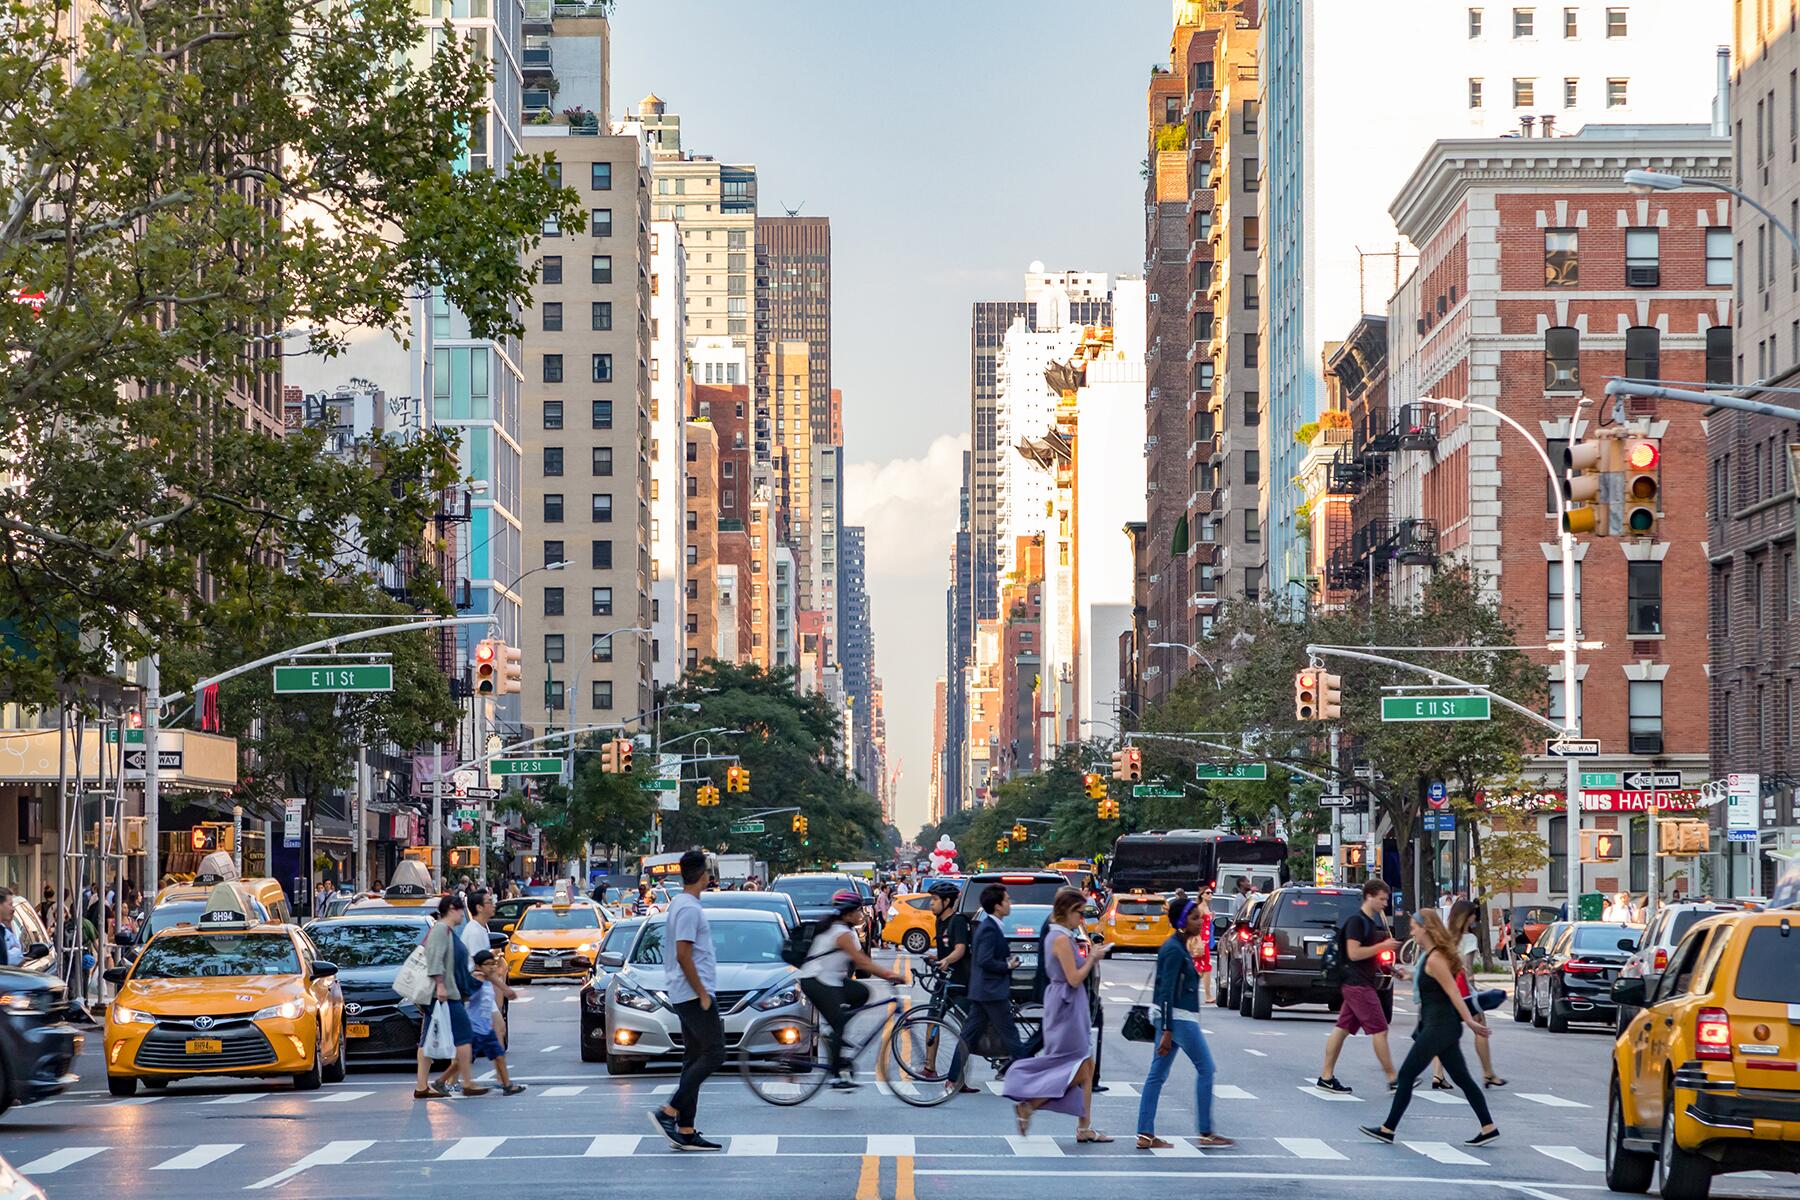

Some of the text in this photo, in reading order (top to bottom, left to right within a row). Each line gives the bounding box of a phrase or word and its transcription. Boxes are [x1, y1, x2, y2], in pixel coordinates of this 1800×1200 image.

[311, 670, 355, 686] E 11 St
[1416, 701, 1456, 715] E 11 St
[110, 731, 117, 742] E
[158, 755, 177, 765] WAY
[511, 761, 542, 772] E 12 St
[1236, 766, 1246, 777] St
[1585, 774, 1591, 785] E
[1595, 774, 1602, 785] 11
[1633, 777, 1676, 785] ONE WAY
[1567, 790, 1612, 810] lus
[398, 884, 413, 894] 7C47
[212, 911, 233, 921] 8H94
